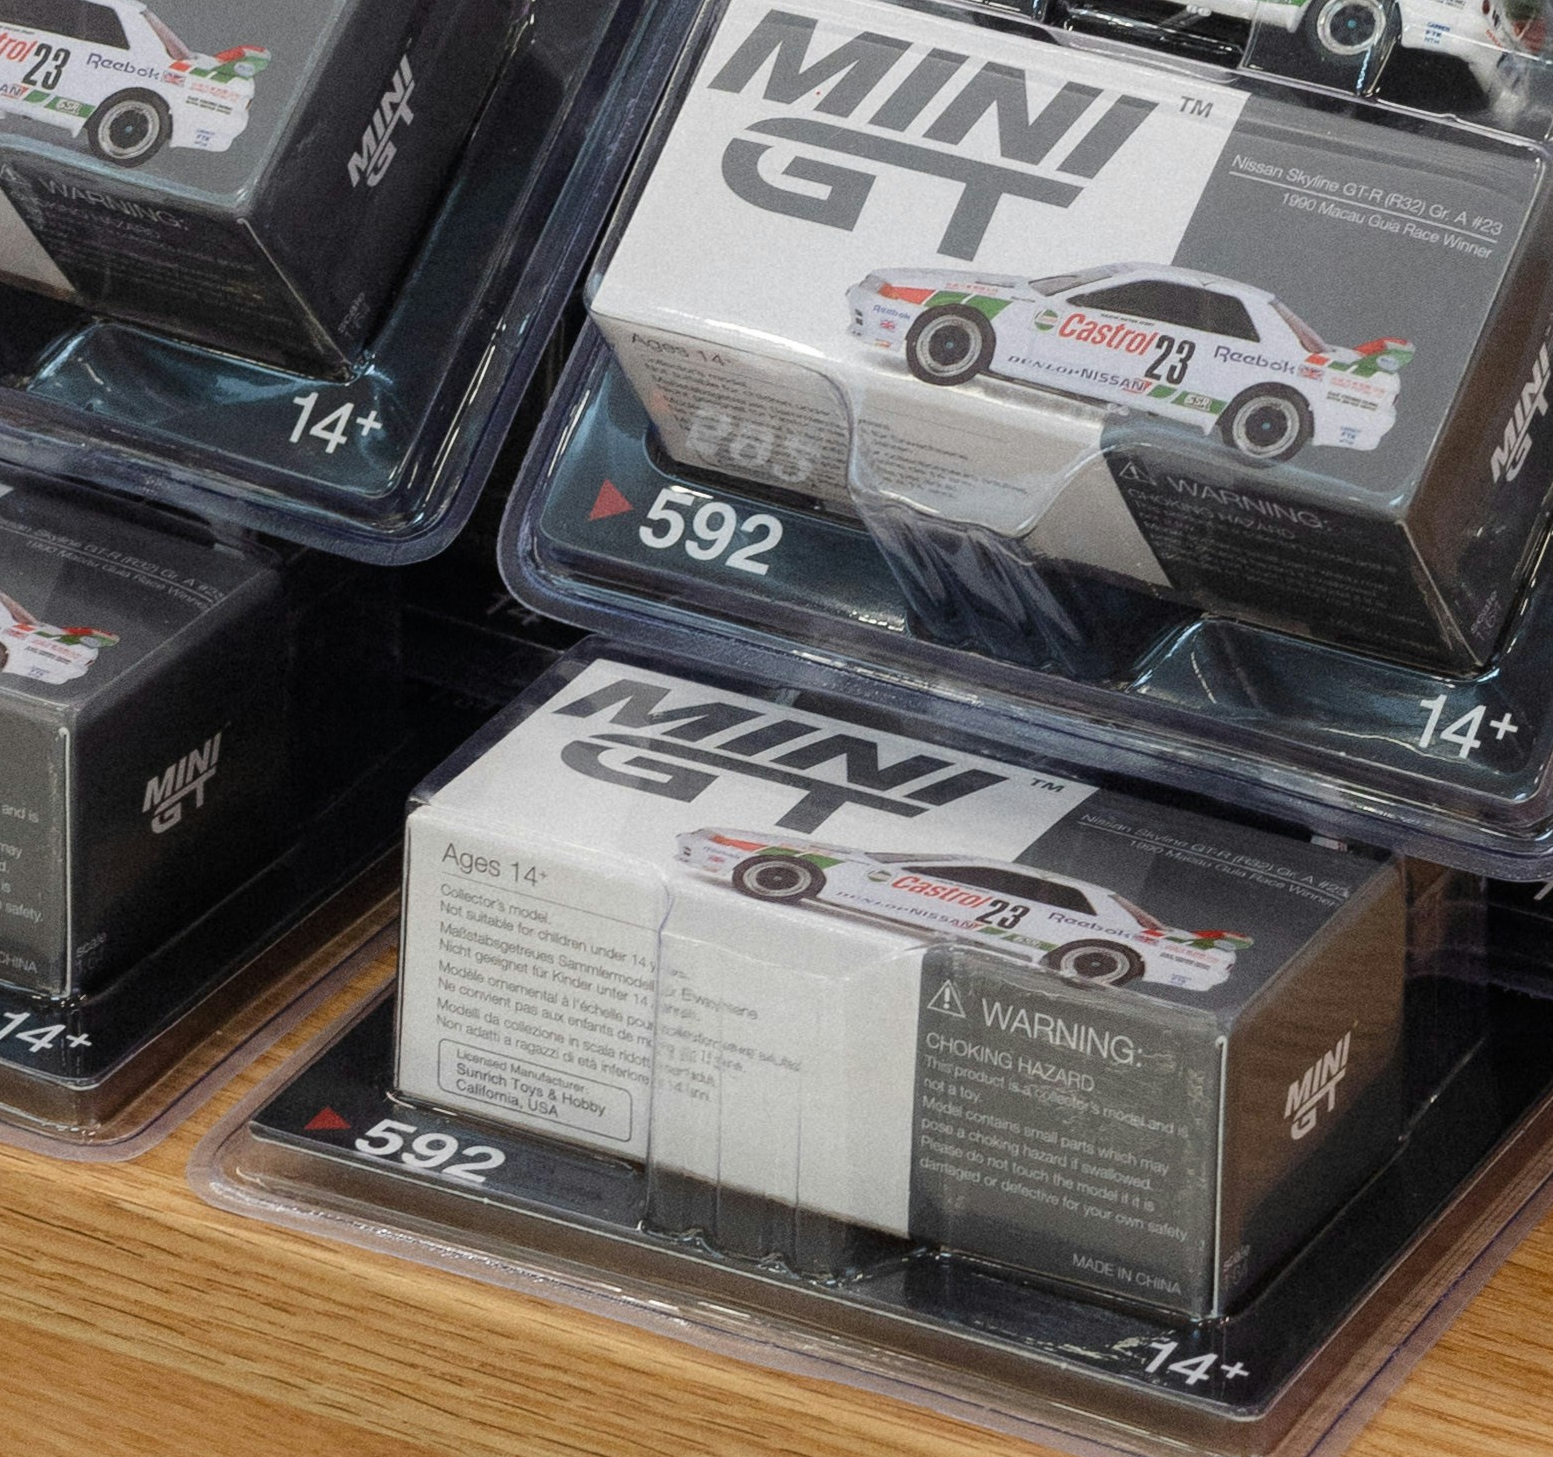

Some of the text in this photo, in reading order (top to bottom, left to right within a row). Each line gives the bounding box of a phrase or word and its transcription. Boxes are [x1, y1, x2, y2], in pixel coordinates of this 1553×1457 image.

[23, 41, 71, 91] 23
[86, 52, 160, 81] Reebok
[707, 8, 1214, 180] MINI TM
[347, 54, 413, 188] MINI
[722, 117, 1085, 262] GT
[1231, 154, 1284, 179] Nissan
[1286, 167, 1340, 193] Skyline
[1343, 183, 1383, 206] GT-R
[1384, 192, 1426, 216] (R32)
[1453, 211, 1468, 225] A
[1471, 215, 1503, 237] #23
[1282, 192, 1493, 260] 1990 Macau Guia Race Winner
[1058, 312, 1157, 357] Castrol
[1144, 335, 1196, 386] 23
[1214, 344, 1295, 377] Reebok
[1079, 368, 1146, 392] NISSAN
[290, 391, 383, 454] 14+
[1490, 342, 1552, 484] MINI
[638, 488, 784, 576] 592
[1166, 476, 1333, 531] WARNING:
[554, 678, 1065, 806] MINI TM
[1419, 693, 1519, 759] 14+
[142, 730, 222, 815] MINI
[150, 771, 217, 835] GT
[559, 732, 933, 835] GT
[441, 842, 548, 887] Ages 14+
[890, 872, 993, 911] Castrol
[440, 882, 551, 925] Collector's model.
[440, 900, 627, 962] Not suitable children under
[975, 897, 1031, 931] 23
[456, 1048, 507, 1072] Licensed
[926, 1032, 1095, 1092] CHOKING HAZARD
[981, 997, 1144, 1068] WARNING:
[456, 1062, 606, 1117] Sunrich Toys & Hobby
[456, 1079, 559, 1118] California, USA
[923, 1077, 945, 1094] not
[947, 1085, 958, 1096] a
[954, 1065, 1005, 1091] product
[1103, 1105, 1145, 1128] model
[1146, 1116, 1174, 1136] and
[1283, 1030, 1352, 1120] MINI
[1290, 1070, 1345, 1141] GT
[354, 1119, 506, 1183] 592
[1072, 1253, 1182, 1295] MADE IN CHINA
[1143, 1340, 1250, 1387] 14+
